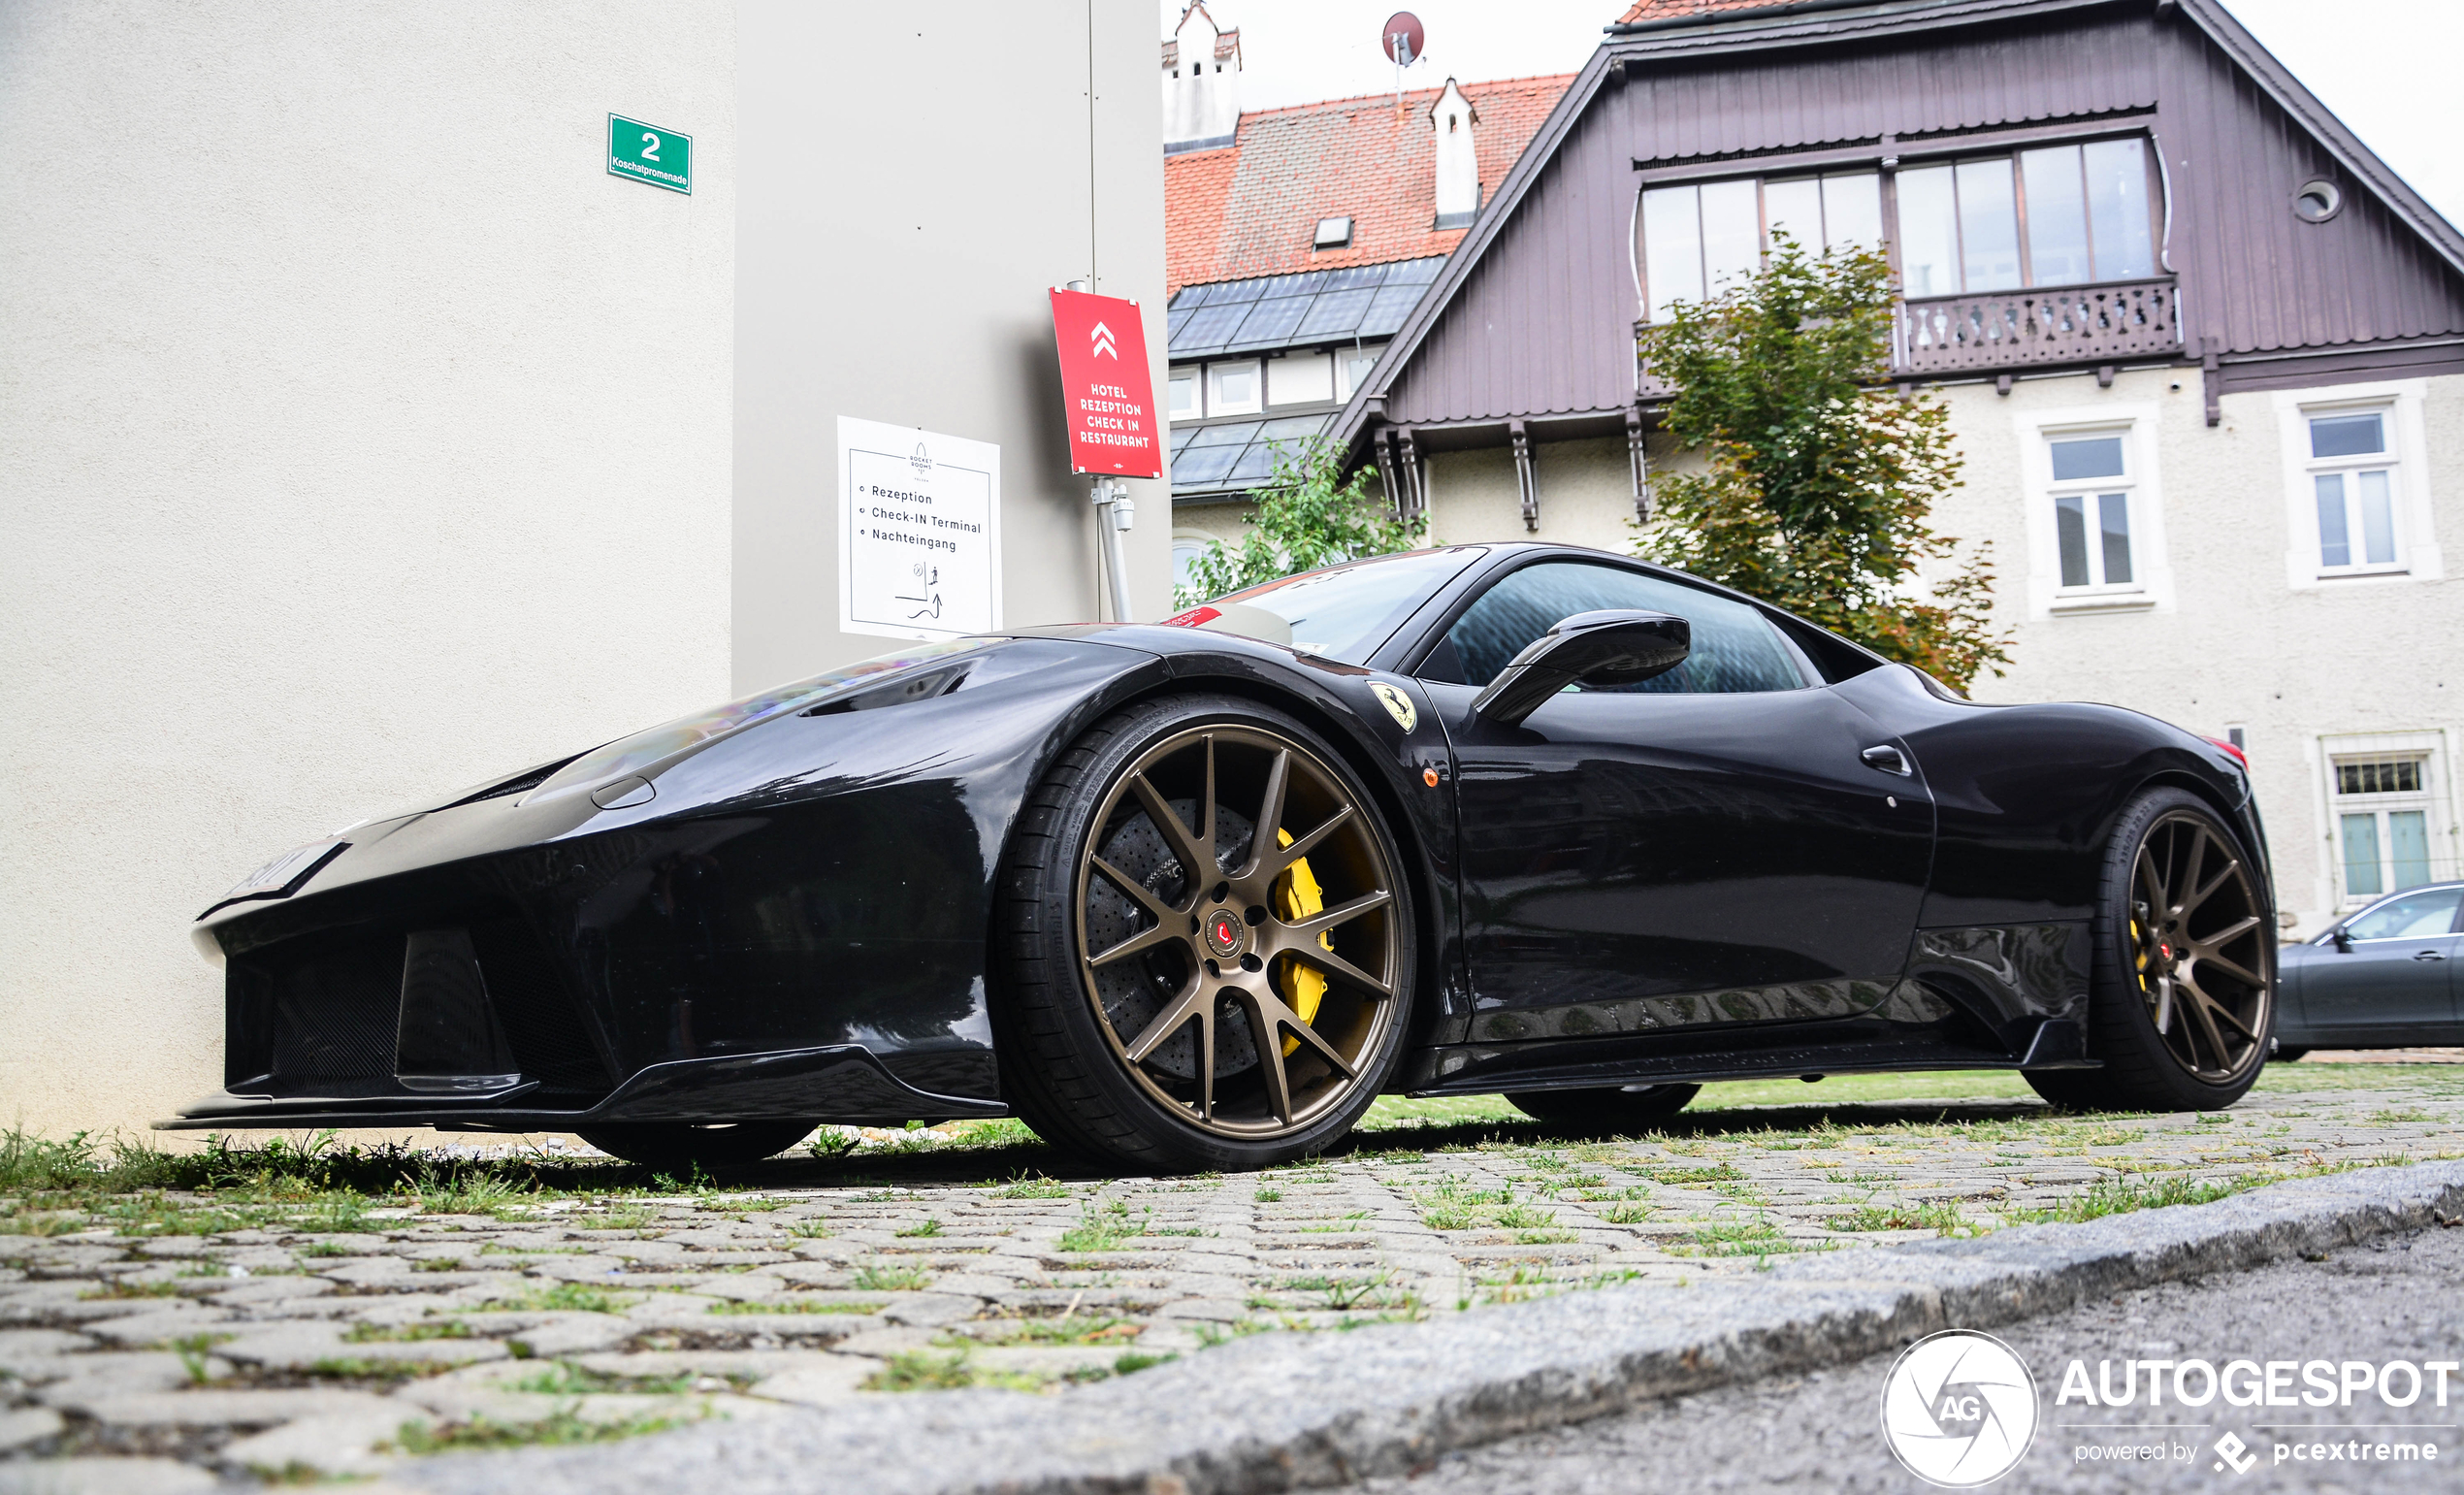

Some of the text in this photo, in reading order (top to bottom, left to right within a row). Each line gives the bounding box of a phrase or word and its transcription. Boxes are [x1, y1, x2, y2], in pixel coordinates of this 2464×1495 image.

[641, 132, 661, 162] 2
[612, 155, 687, 185] Koschatpromenade
[1090, 383, 1128, 399] HOTEL
[1080, 399, 1142, 416] REZEPTION
[1086, 415, 1140, 432] CHECK IN
[1080, 432, 1150, 448] RESTAURANT
[871, 485, 933, 504] Rezeption
[871, 507, 982, 534] Check-IN Terminal
[872, 529, 956, 553] Nachteingang
[1050, 915, 1078, 1000] Continental
